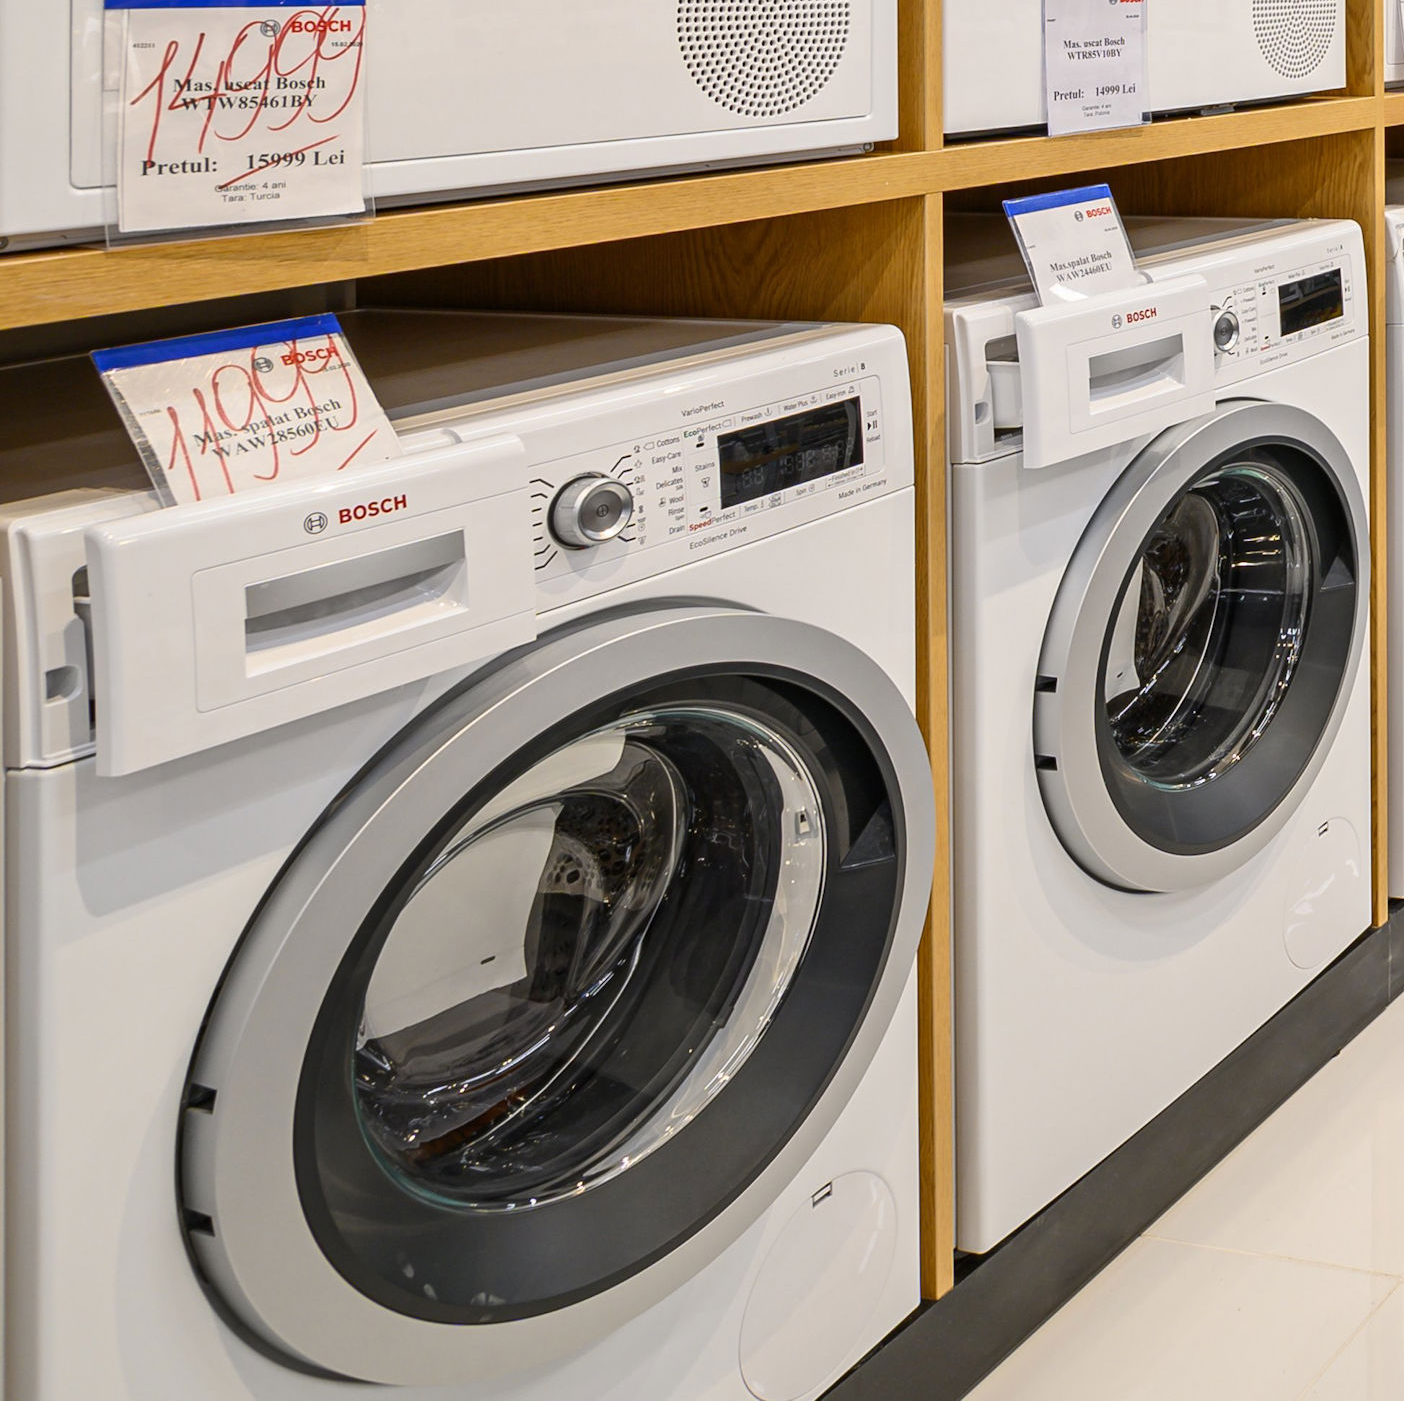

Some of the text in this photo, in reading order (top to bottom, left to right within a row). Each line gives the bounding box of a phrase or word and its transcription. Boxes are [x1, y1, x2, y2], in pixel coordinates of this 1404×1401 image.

[291, 20, 351, 34] BOSCH
[1104, 36, 1126, 47] Bosch
[173, 78, 217, 93] Mas.
[276, 76, 326, 90] Bosch
[1054, 83, 1136, 102] Pretul: 14999 Lei
[141, 149, 345, 177] Pretul: 15999 Lei
[262, 182, 269, 190] 4
[271, 181, 287, 190] ani
[249, 192, 281, 201] Turcia
[1085, 206, 1112, 218] BOSCH
[1090, 250, 1113, 264] Bosch
[1127, 307, 1157, 324] BOSCH
[280, 346, 338, 367] BOSCH
[833, 362, 867, 378] Serie 8
[680, 399, 726, 418] VarioPerfect
[193, 397, 342, 447] Mas. spalat Bosch
[683, 422, 723, 439] EcoPerfect
[656, 435, 681, 448] Cottons
[672, 465, 683, 474] Mix
[694, 461, 716, 473] Stains
[655, 477, 684, 491] Delicates
[838, 489, 856, 500] Made
[862, 478, 889, 492] Germany
[668, 494, 685, 505] Wool
[338, 493, 408, 525] BOSCH
[667, 506, 685, 517] Rinse
[689, 512, 736, 532] SpeedPerfect
[668, 524, 686, 536] Drain
[689, 525, 748, 551] EcoSilence Drive
